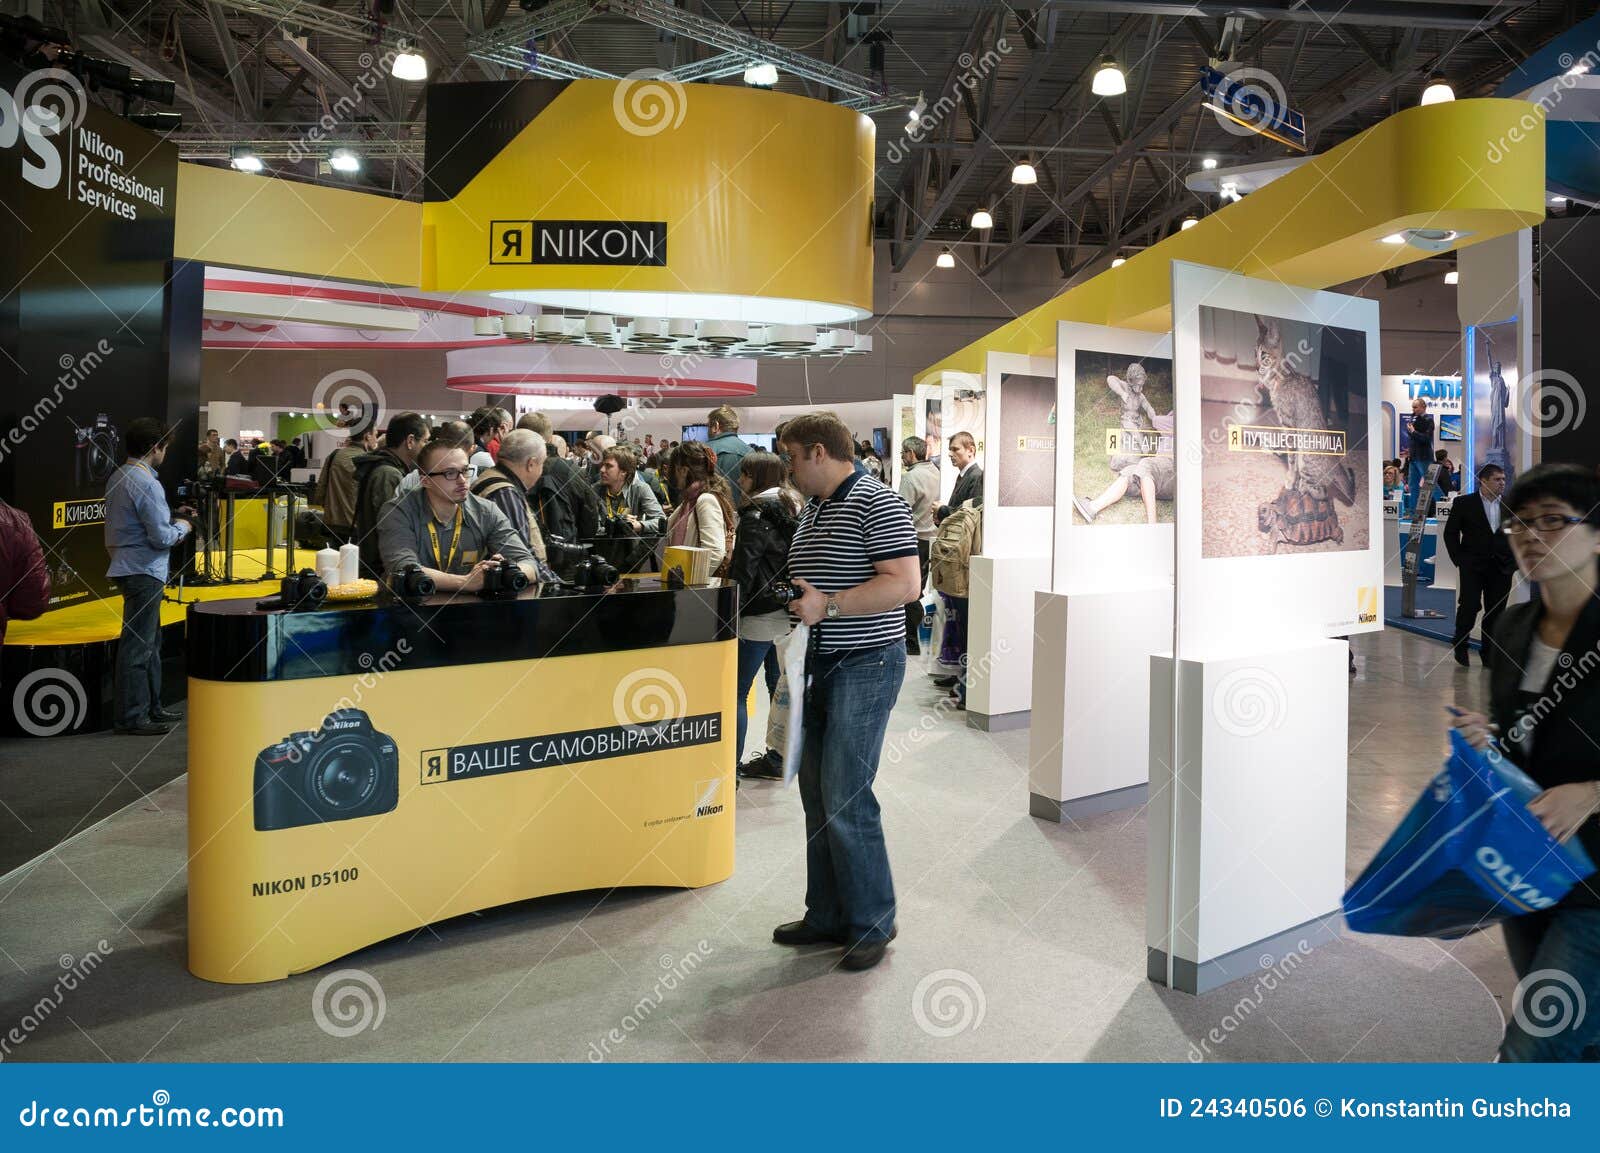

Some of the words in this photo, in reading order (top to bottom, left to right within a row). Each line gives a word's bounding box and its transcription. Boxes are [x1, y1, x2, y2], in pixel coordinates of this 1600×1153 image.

[79, 127, 124, 166] Nikon
[78, 153, 164, 207] Professional
[77, 180, 137, 221] Services
[501, 229, 522, 257] Я
[541, 228, 654, 259] NIKON
[1109, 434, 1117, 449] Я
[1122, 434, 1140, 451] НЕ
[1141, 435, 1173, 451] АНГЕ
[1231, 431, 1238, 445] Я
[1242, 430, 1343, 453] ПУТЕШЕСТВЕННИЦА
[56, 507, 63, 524] Я
[1358, 612, 1377, 624] Nikon
[333, 720, 361, 729] Nikon
[426, 755, 441, 777] Я
[453, 745, 521, 774] ВАШЕ
[529, 718, 718, 763] САМОВЫРАЖЕНИЕ
[696, 804, 724, 817] Nikon
[252, 876, 305, 897] NIKON
[311, 867, 359, 888] D5100
